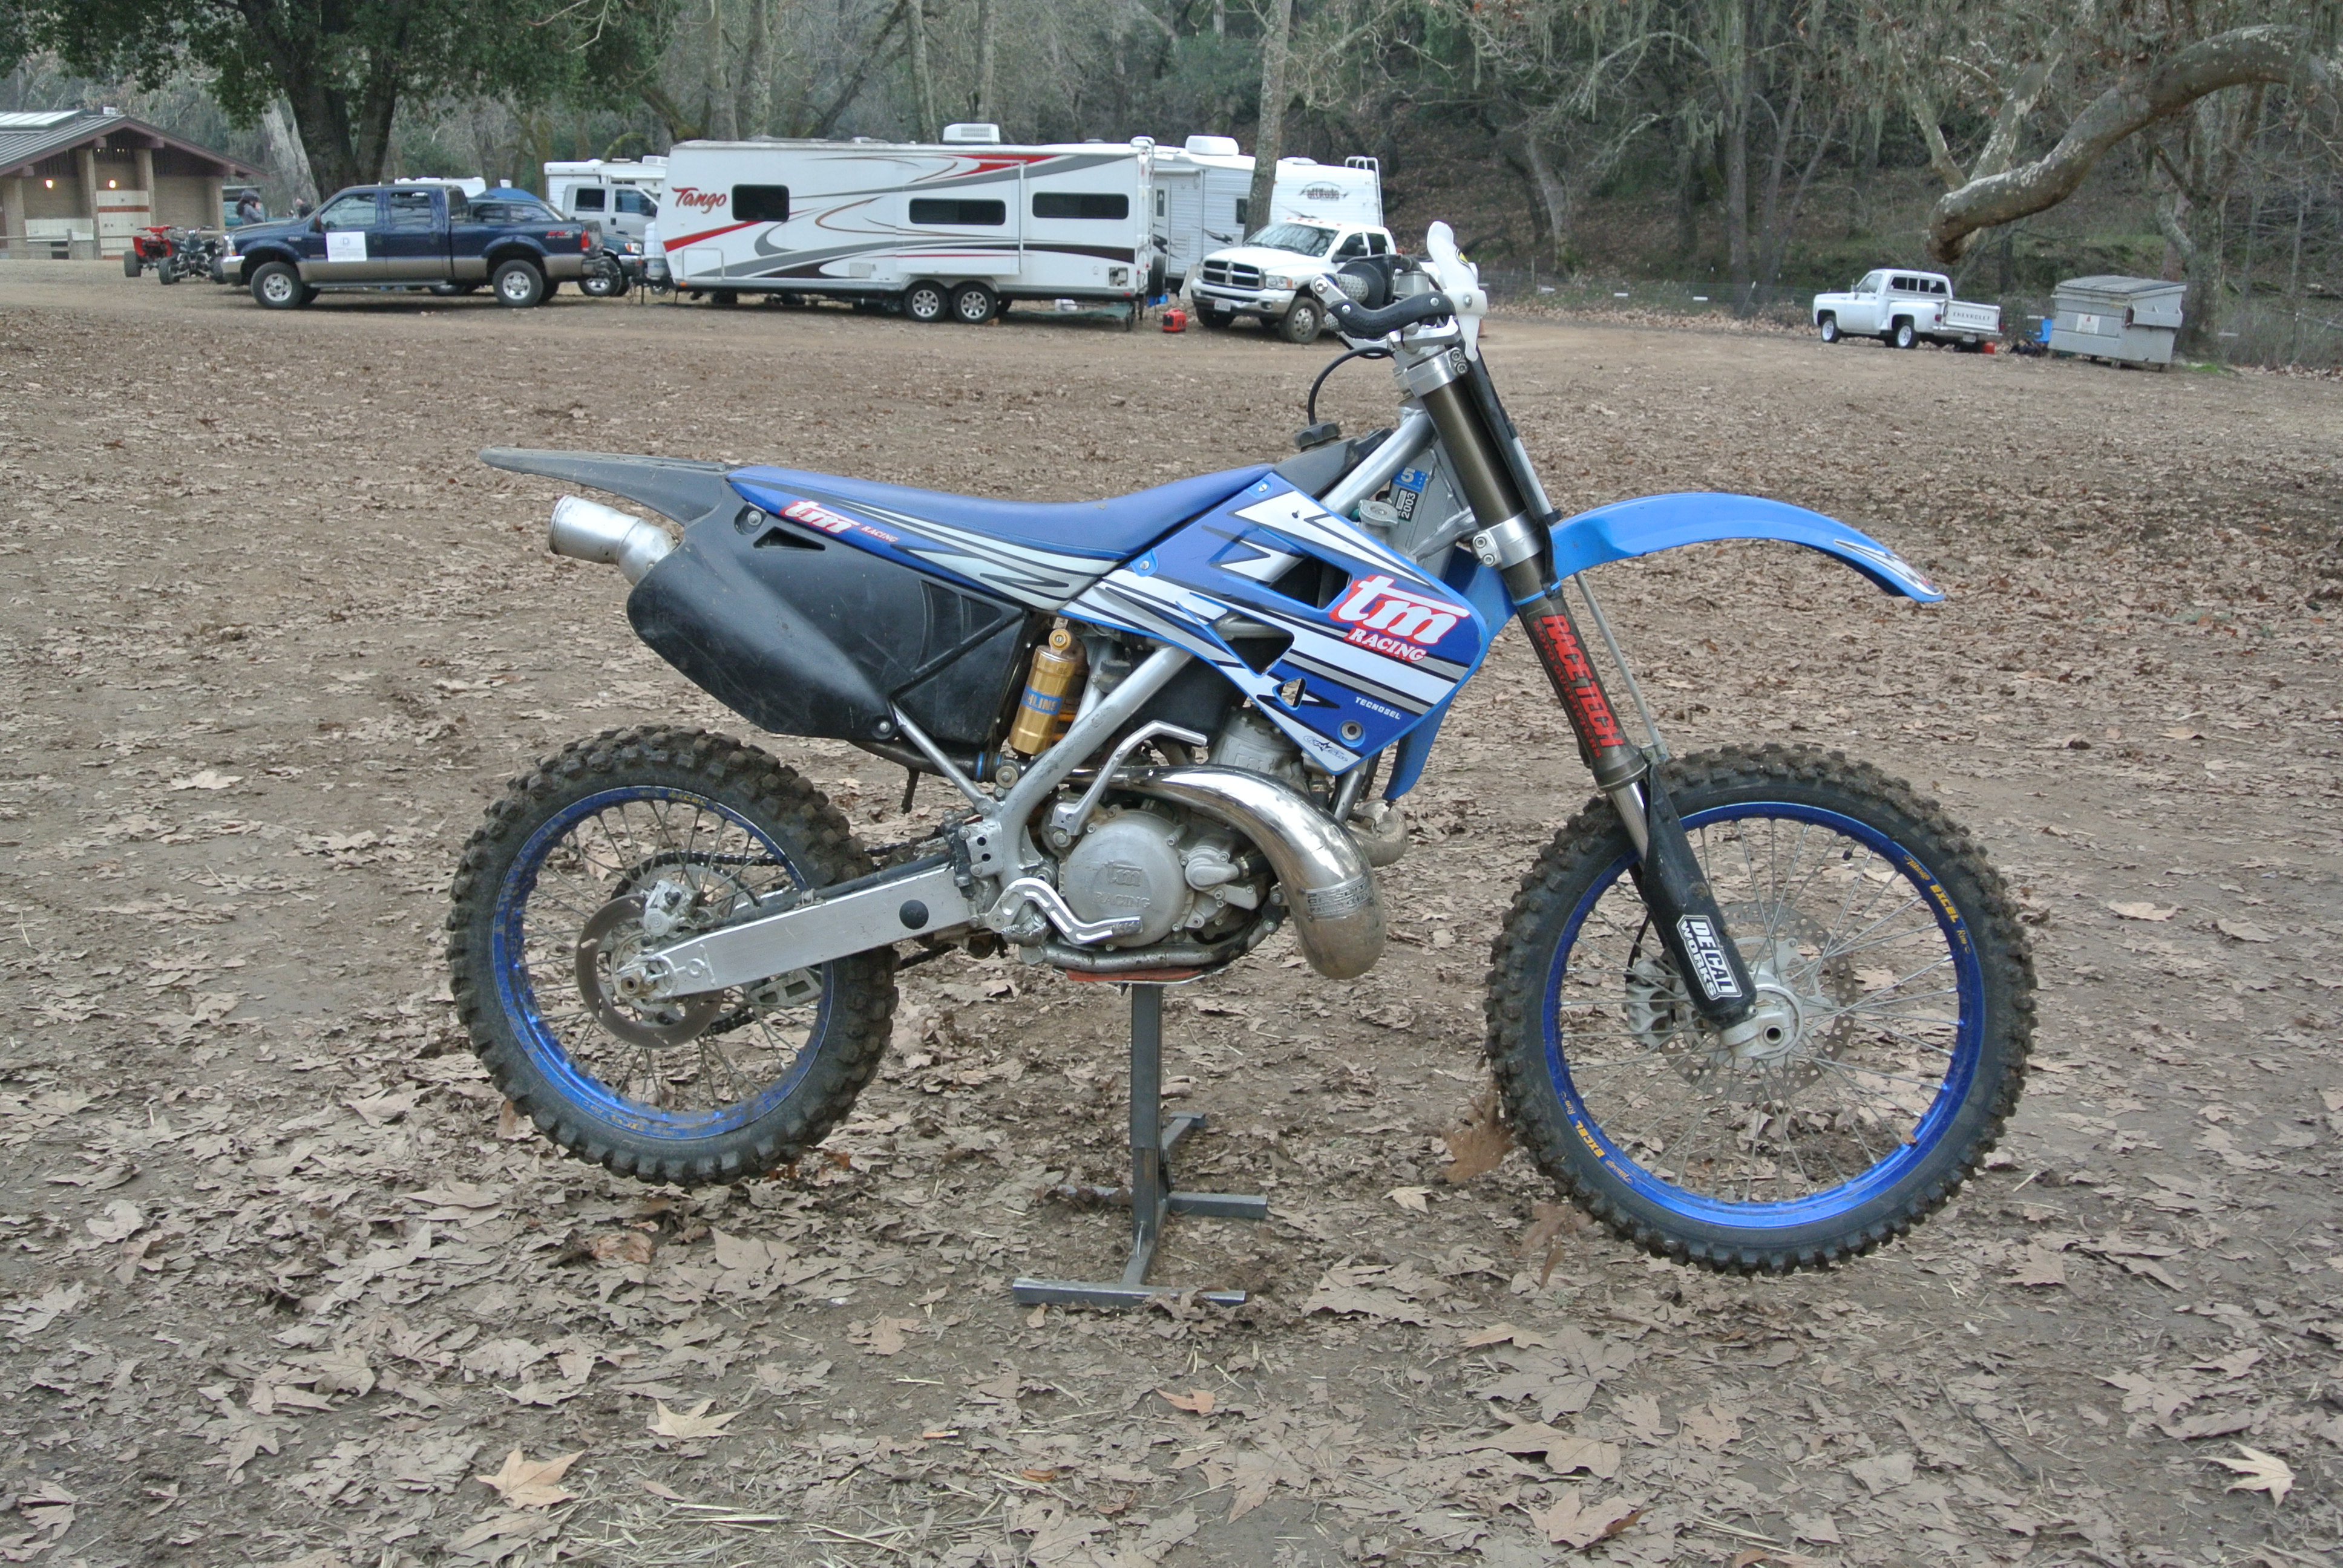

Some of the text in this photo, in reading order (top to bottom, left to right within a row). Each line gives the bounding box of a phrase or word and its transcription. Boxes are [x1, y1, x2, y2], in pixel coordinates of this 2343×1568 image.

[671, 186, 727, 214] Tango
[1953, 312, 1990, 321] CHEVROLET
[1400, 467, 1415, 483] 5
[1401, 492, 1416, 519] 2003
[860, 525, 900, 543] RACING
[1335, 574, 1471, 645] tm
[1347, 627, 1427, 662] RACING
[1540, 613, 1625, 747] RACE TECH
[1355, 696, 1401, 720] TECNOSEL
[1930, 884, 1959, 923] EXCEL
[1680, 920, 1717, 997] WORKS
[1689, 921, 1738, 994] DECAL
[1575, 1120, 1605, 1158] EXCEL
